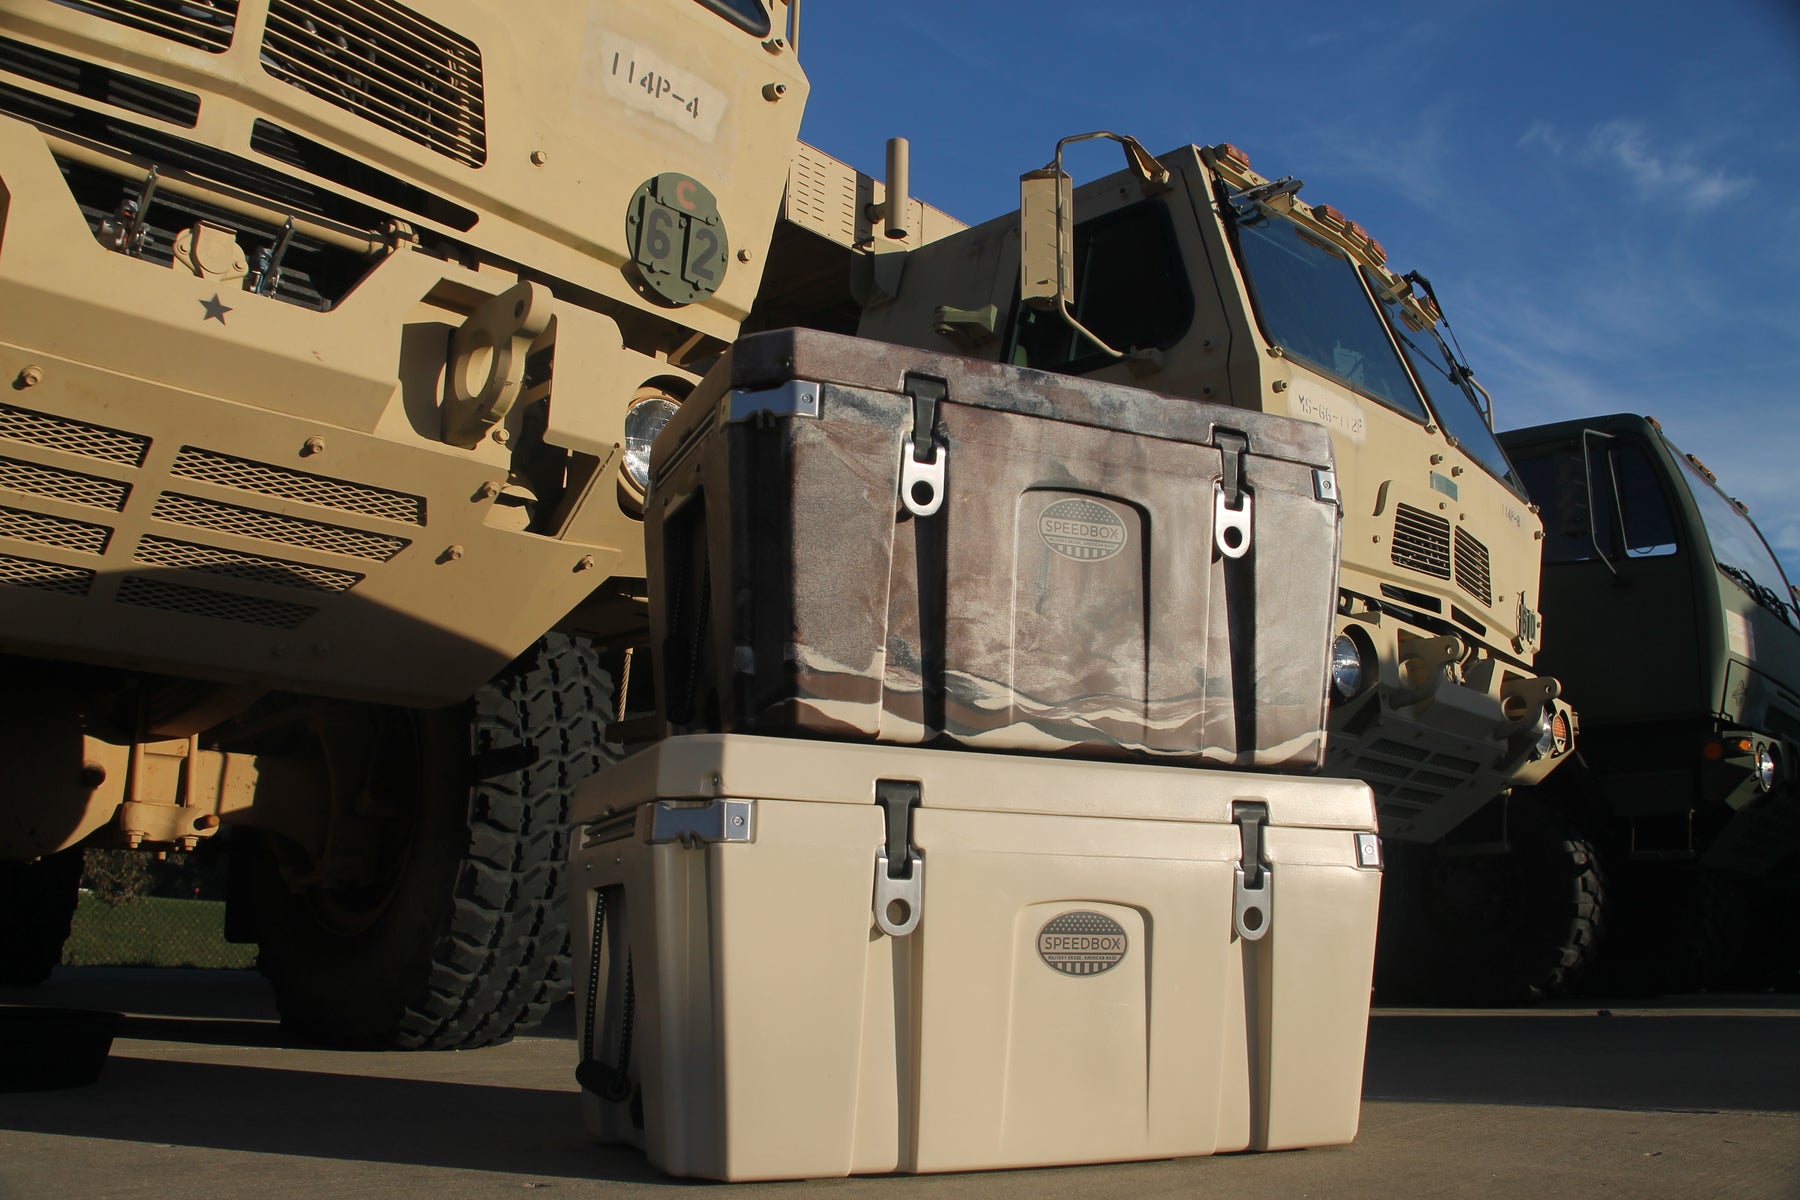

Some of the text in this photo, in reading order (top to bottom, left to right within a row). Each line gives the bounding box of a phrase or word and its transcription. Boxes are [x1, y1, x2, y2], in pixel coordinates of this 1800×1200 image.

[612, 52, 698, 118] 114P-4
[676, 180, 697, 210] C
[1045, 520, 1119, 540] SPEEDBOX
[1044, 936, 1121, 950] SPEEDBOX
